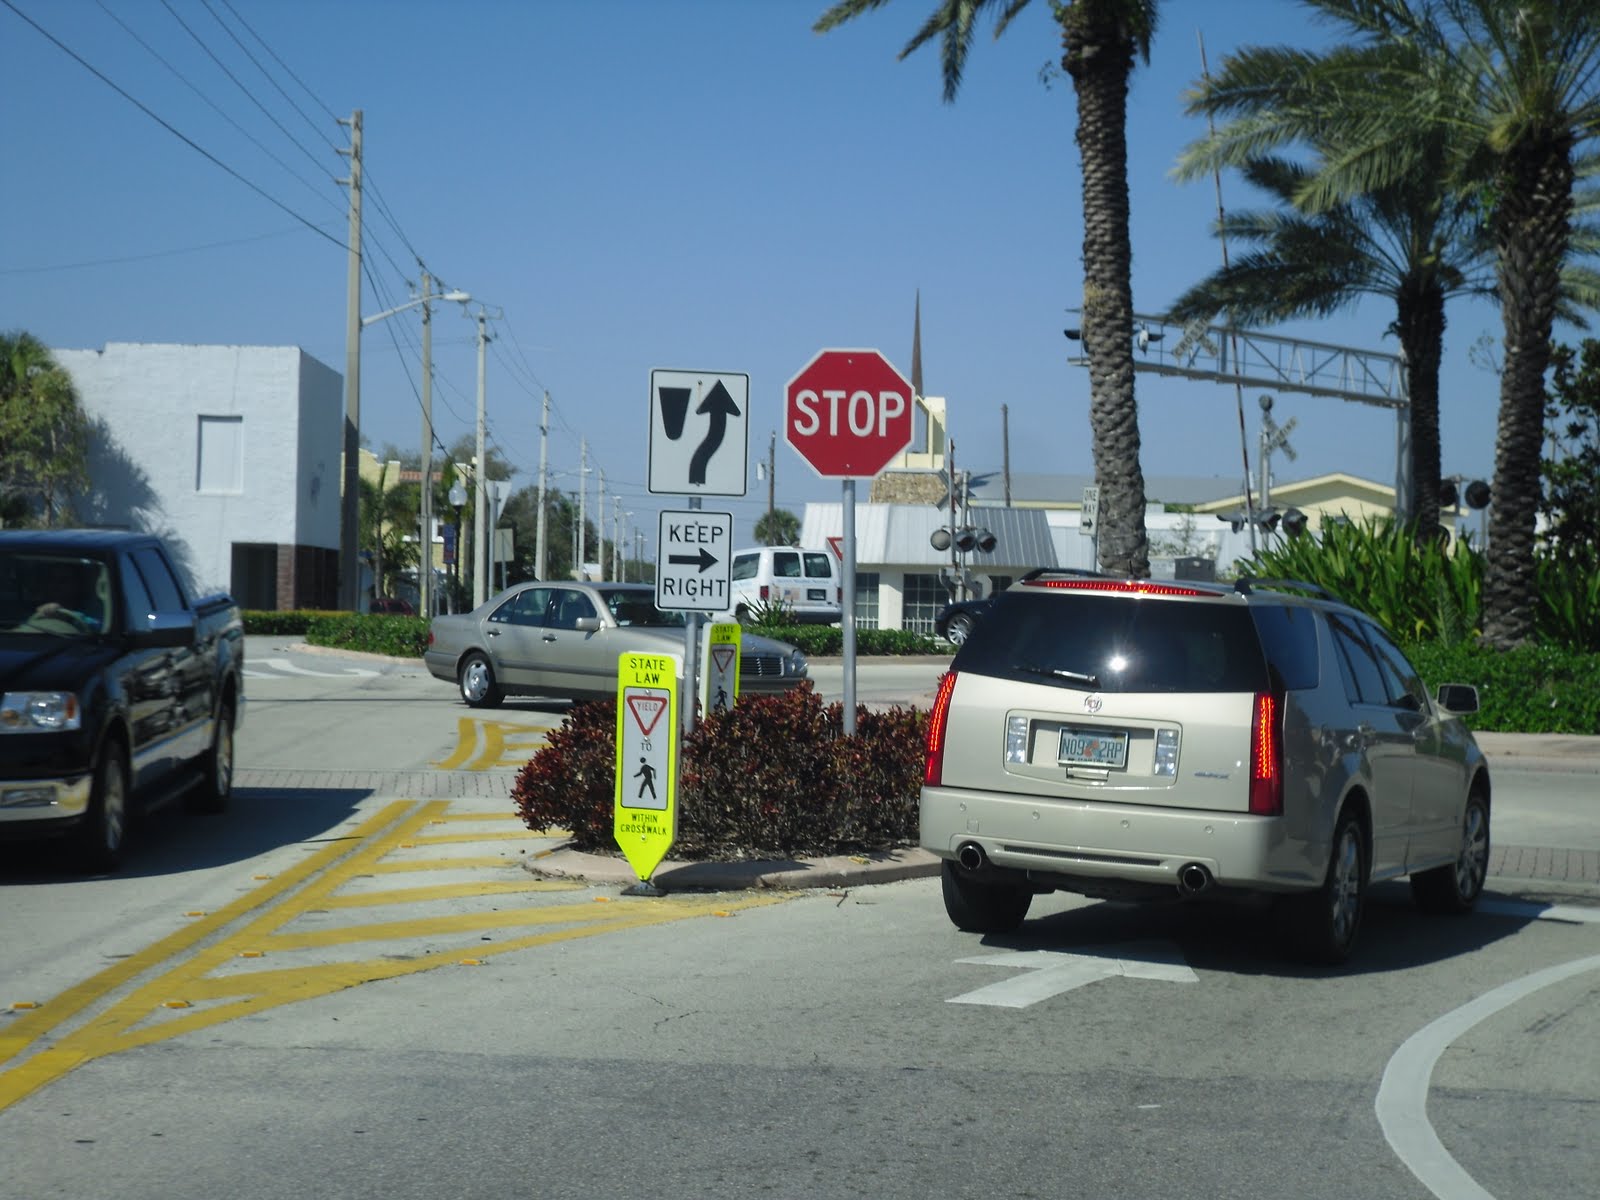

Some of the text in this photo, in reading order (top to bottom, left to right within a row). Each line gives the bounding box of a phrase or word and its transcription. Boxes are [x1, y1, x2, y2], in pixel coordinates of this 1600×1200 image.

[794, 389, 905, 437] STOP
[1084, 490, 1096, 501] ONE
[1083, 503, 1097, 514] WAY
[669, 524, 724, 544] KEEP
[663, 577, 727, 598] RIGHT
[630, 658, 666, 671] STATE
[635, 672, 660, 684] LAW
[637, 701, 658, 712] YIELD
[640, 741, 653, 752] TO
[632, 813, 658, 823] WITHIN
[620, 823, 667, 836] CROSSWALK
